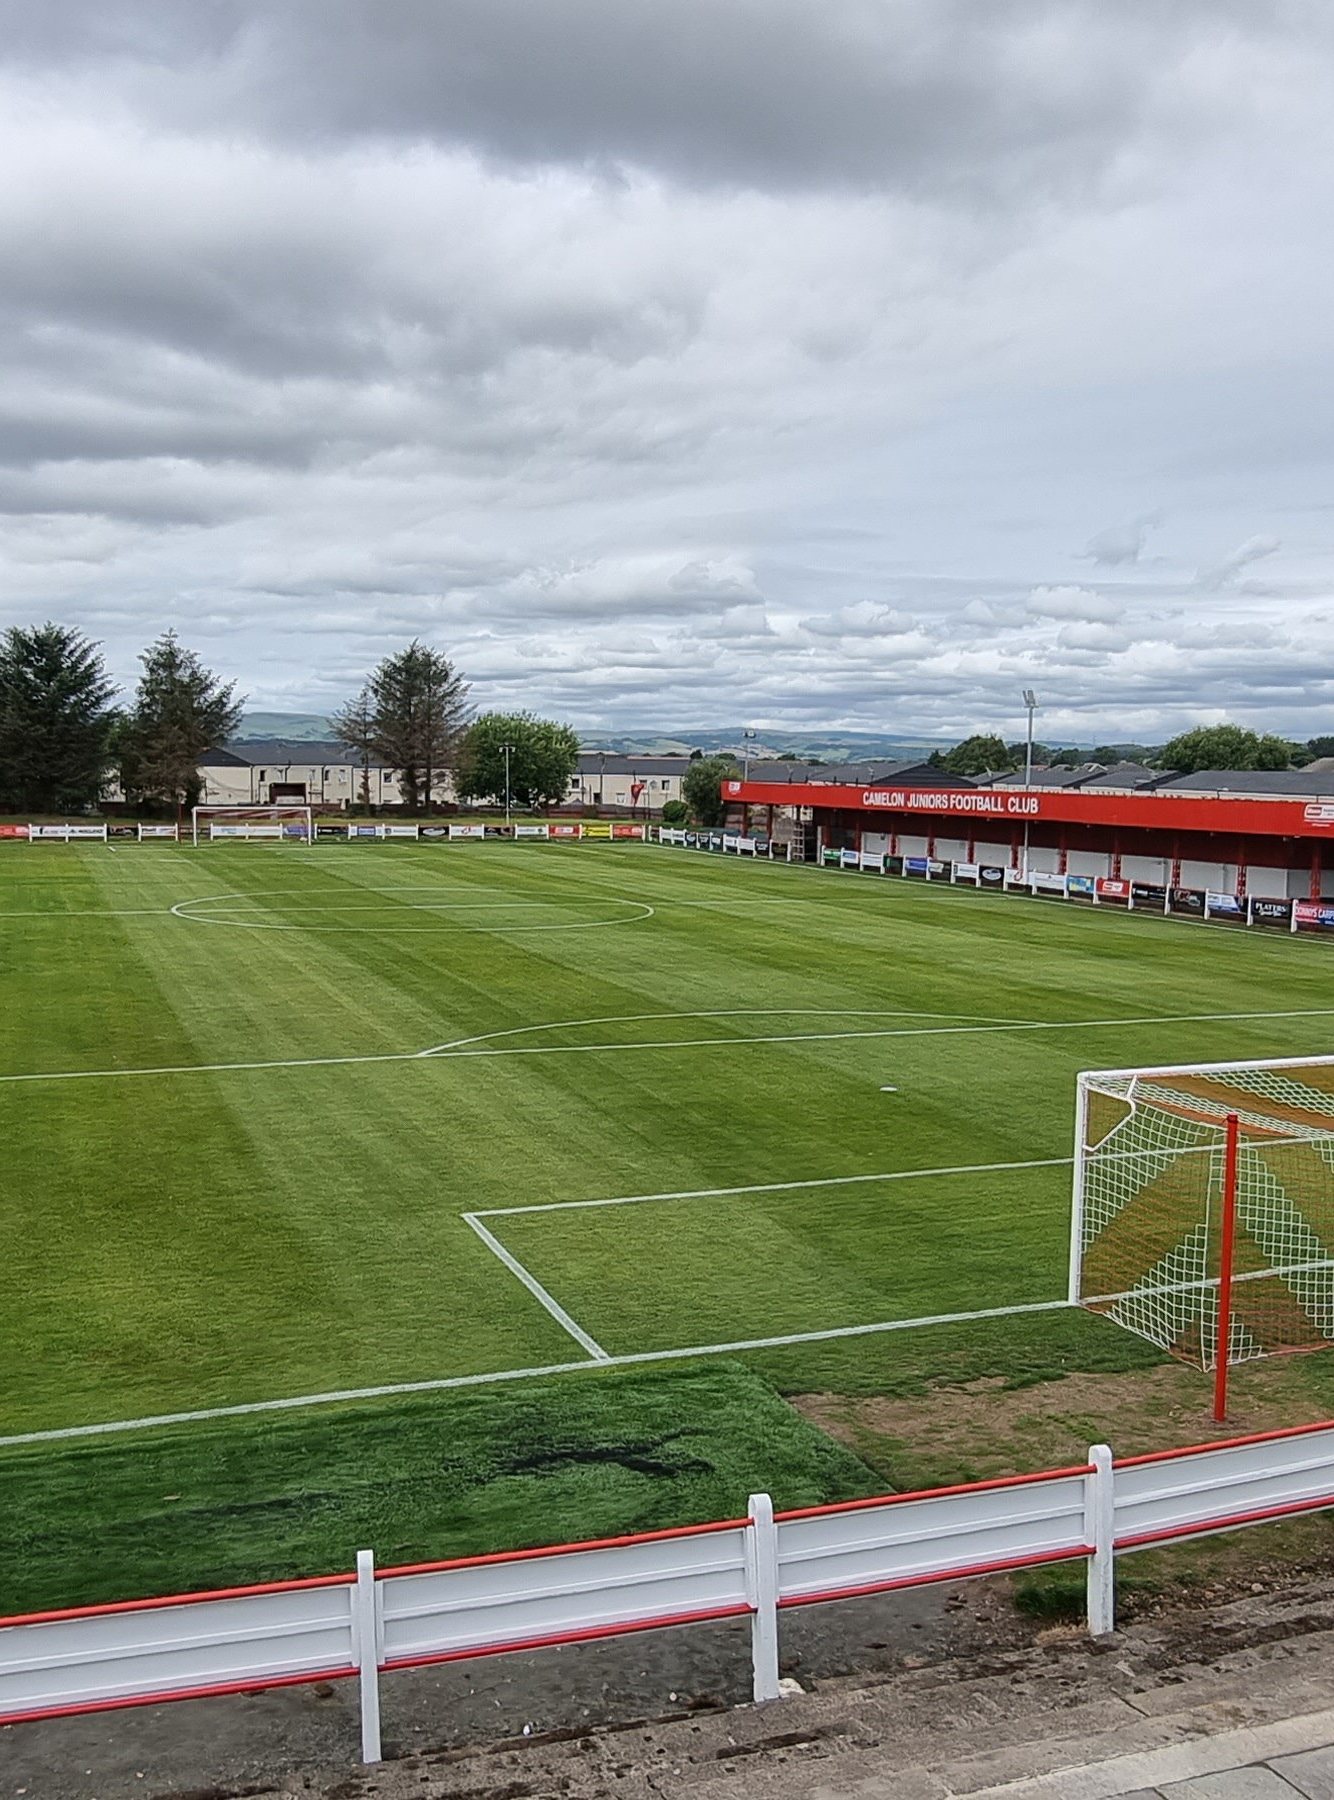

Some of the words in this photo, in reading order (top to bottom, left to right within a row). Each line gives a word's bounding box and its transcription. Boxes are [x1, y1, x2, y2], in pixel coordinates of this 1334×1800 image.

[863, 792, 904, 807] CAMELON
[906, 793, 948, 809] JUNIORS
[950, 795, 1004, 812] FOOTBALL
[1008, 797, 1039, 814] CLUB
